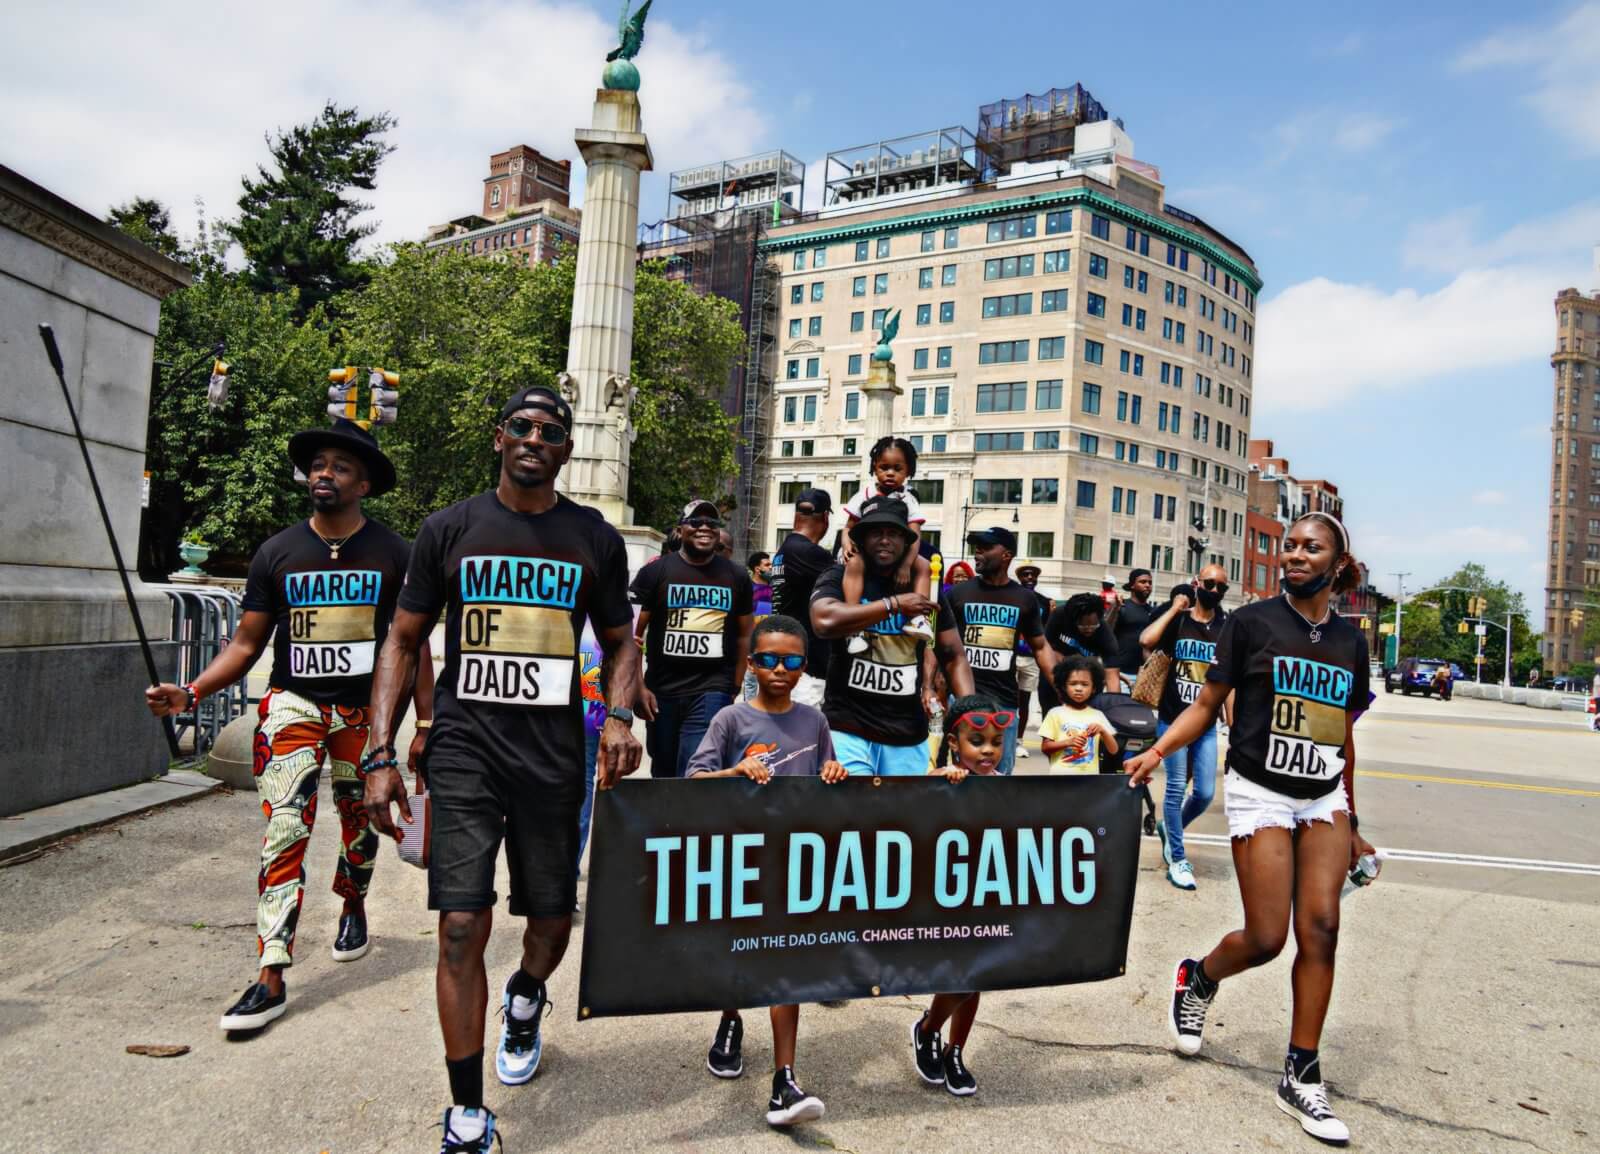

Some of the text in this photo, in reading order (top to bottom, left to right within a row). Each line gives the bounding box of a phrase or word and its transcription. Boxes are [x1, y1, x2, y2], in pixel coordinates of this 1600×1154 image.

[290, 573, 377, 603] MARCH
[466, 559, 576, 604] MARCH
[670, 586, 729, 609] MARCH
[293, 610, 318, 638] OF
[465, 608, 502, 647] OF
[668, 609, 690, 628] OF
[966, 605, 1017, 626] MARCH
[665, 633, 710, 655] DADS
[966, 626, 984, 644] OF
[293, 646, 351, 674] DADS
[966, 648, 1000, 668] DADS
[1176, 640, 1216, 660] MARC
[463, 658, 541, 700] DADS
[851, 661, 904, 692] DADS
[1177, 662, 1193, 679] OF
[1276, 699, 1306, 732] OF
[1270, 738, 1326, 776] DAD
[645, 833, 765, 925] THE
[787, 830, 913, 914] DAD
[731, 924, 1014, 952] JOIN THE DAD GANG. CHANGE THE DAD GAME.
